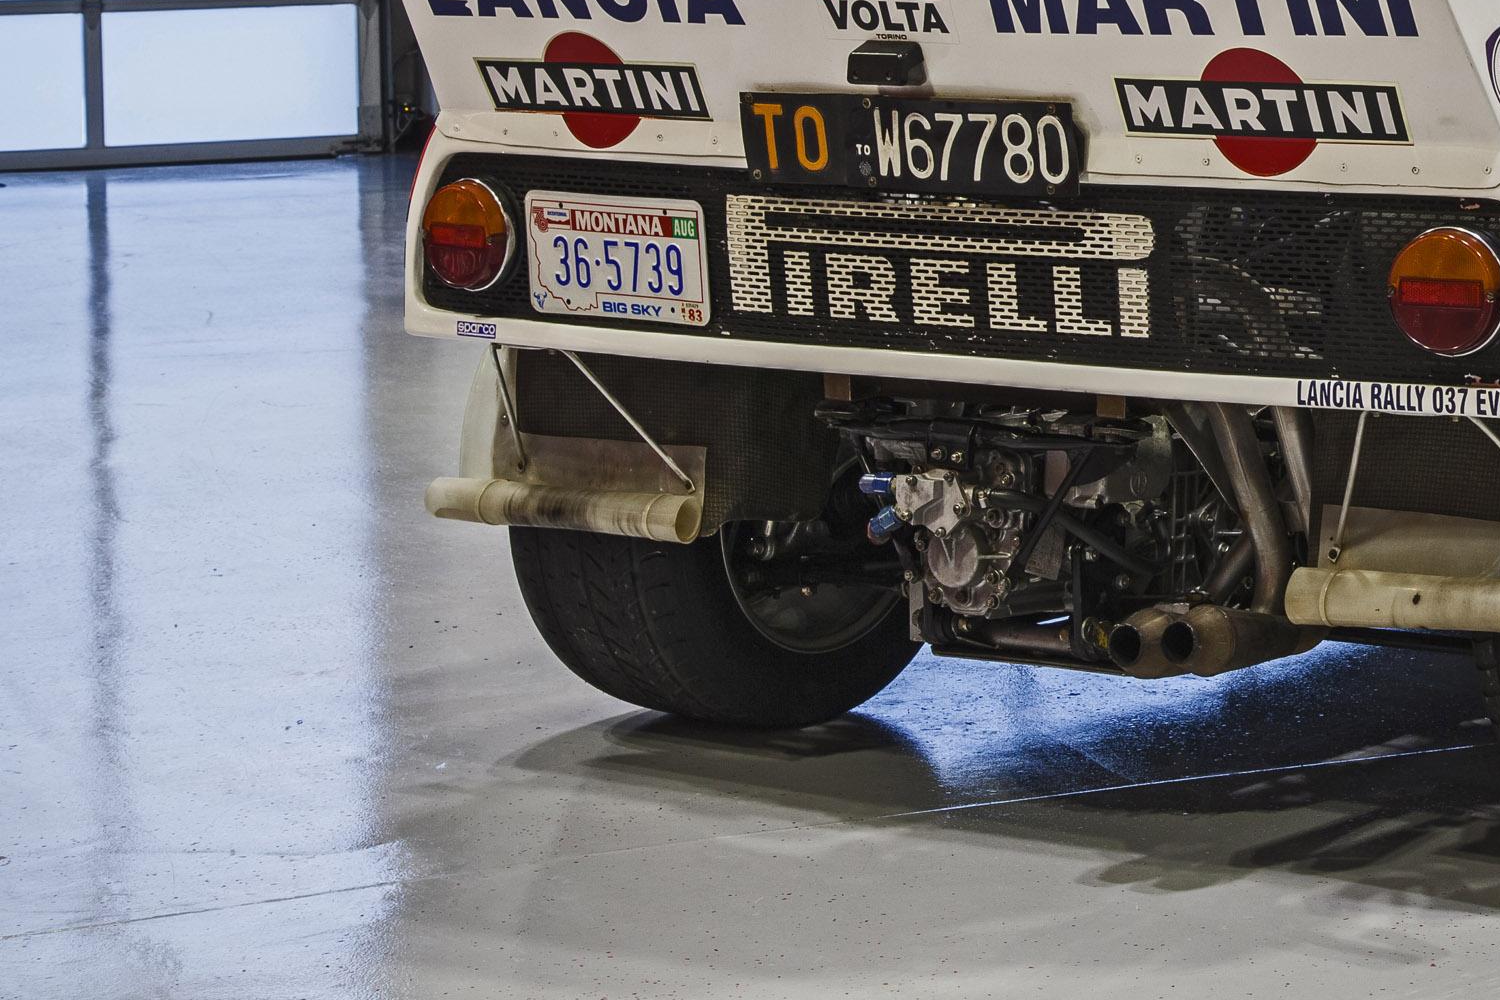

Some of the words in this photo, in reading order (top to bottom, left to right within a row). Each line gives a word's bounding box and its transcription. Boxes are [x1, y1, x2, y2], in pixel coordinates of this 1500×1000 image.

[823, 0, 950, 34] VOLTA
[485, 66, 701, 111] MARTINI
[1125, 84, 1398, 135] MARTINI
[753, 103, 829, 173] TO
[856, 144, 871, 156] TO
[874, 107, 1069, 184] W67780
[575, 210, 664, 237] MONTANA
[674, 219, 695, 237] AUG
[727, 194, 1155, 339] PIRELLI
[602, 301, 628, 314] BIG
[631, 303, 662, 316] SKY
[688, 308, 703, 322] 83
[458, 322, 496, 335] sparco
[1297, 380, 1364, 408] LANCIA
[1371, 383, 1425, 411] RALLY
[1432, 386, 1469, 414] 037
